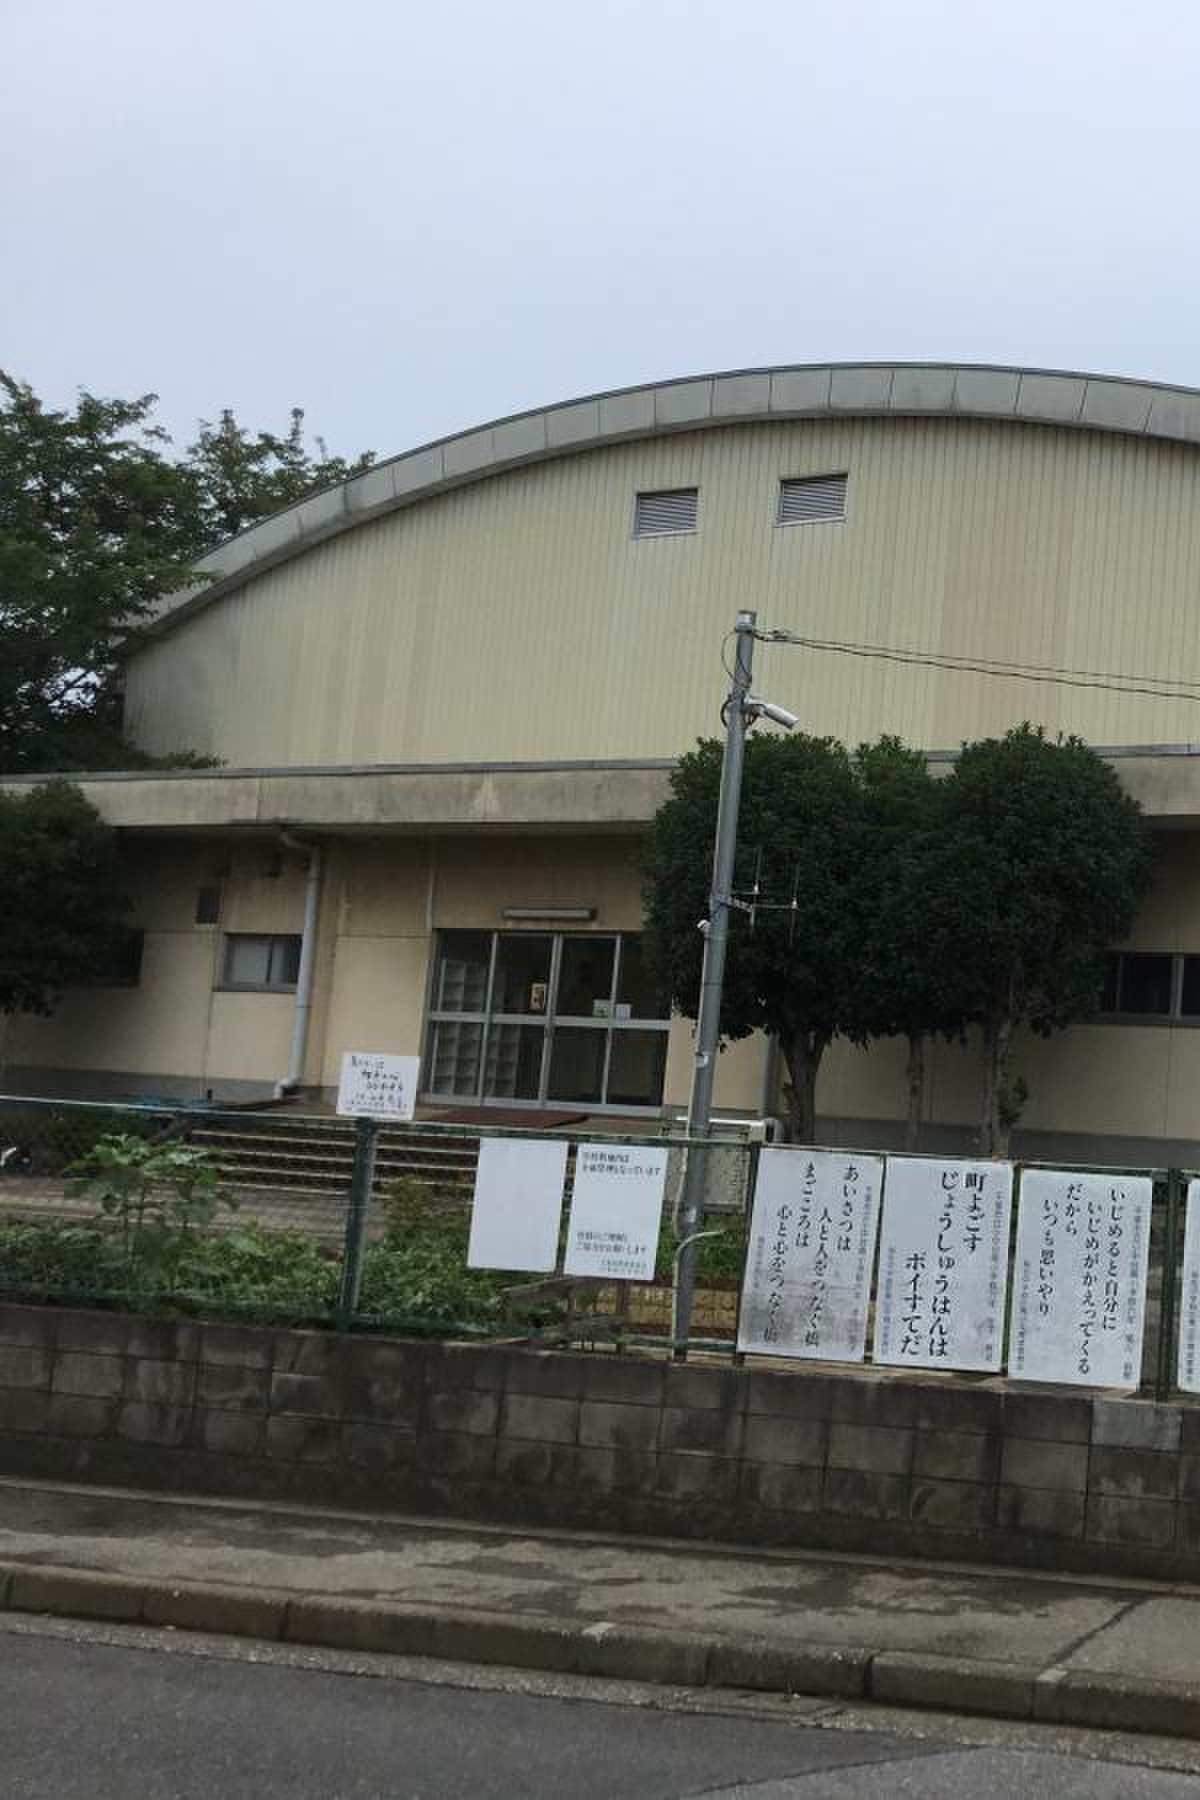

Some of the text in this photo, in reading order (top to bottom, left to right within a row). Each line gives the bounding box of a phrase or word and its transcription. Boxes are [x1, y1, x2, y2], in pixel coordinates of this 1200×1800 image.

[795, 1161, 817, 1248] まごころは
[837, 1164, 859, 1251] あいさつは
[962, 1171, 988, 1255] 町よごす
[1064, 1182, 1084, 1237] だから
[928, 1170, 960, 1357] じょうしゅうはんは
[1037, 1198, 1059, 1317] いつも思いやり
[1077, 1201, 1102, 1375] いじめがかえってくる
[1103, 1187, 1126, 1331] いじめると自分に
